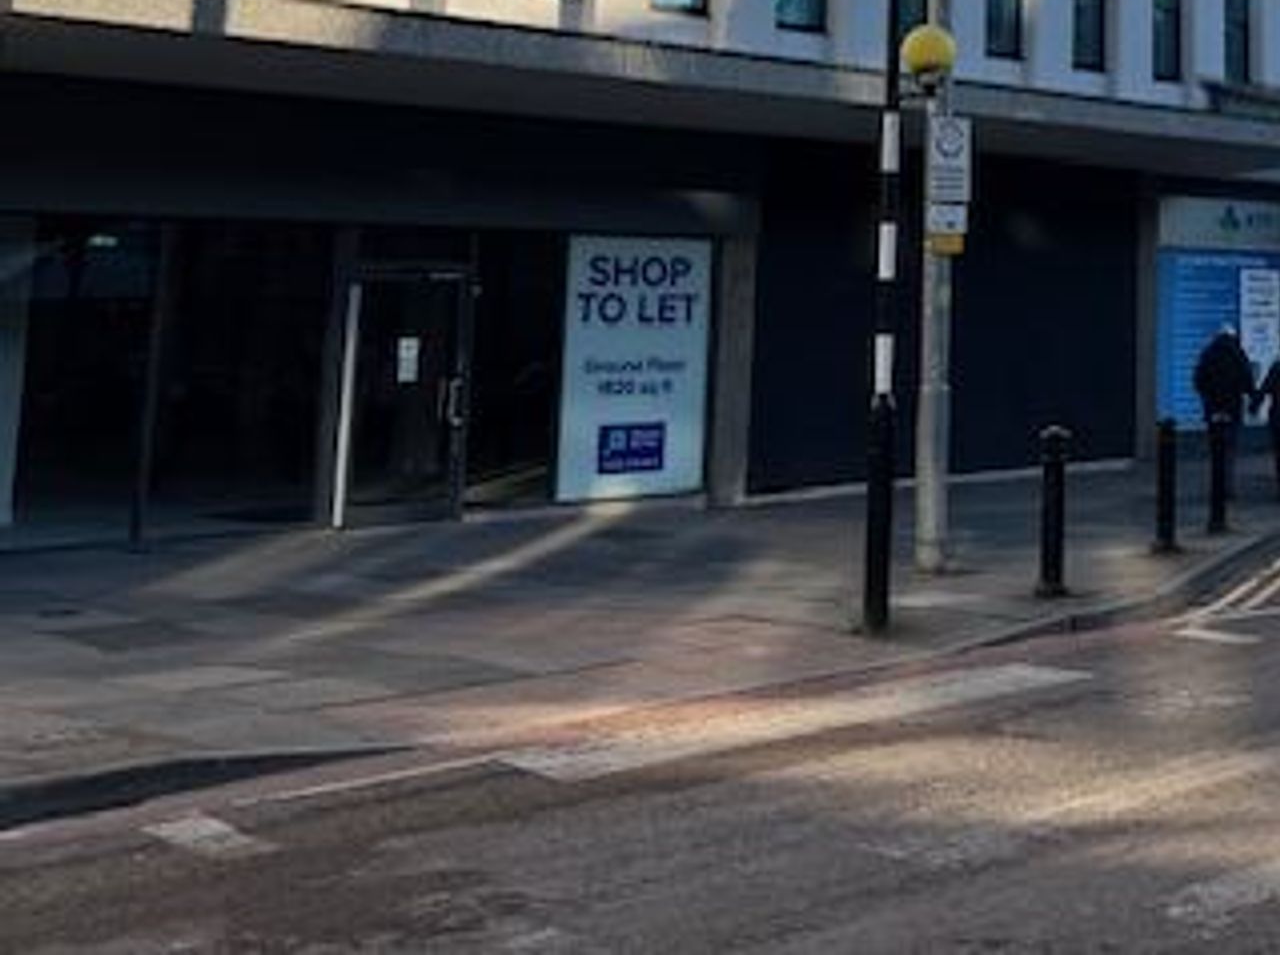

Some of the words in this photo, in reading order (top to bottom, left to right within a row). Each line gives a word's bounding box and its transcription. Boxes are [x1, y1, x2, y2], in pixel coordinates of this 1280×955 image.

[587, 255, 692, 287] SHOP
[577, 292, 627, 324] TO
[637, 292, 700, 324] LET
